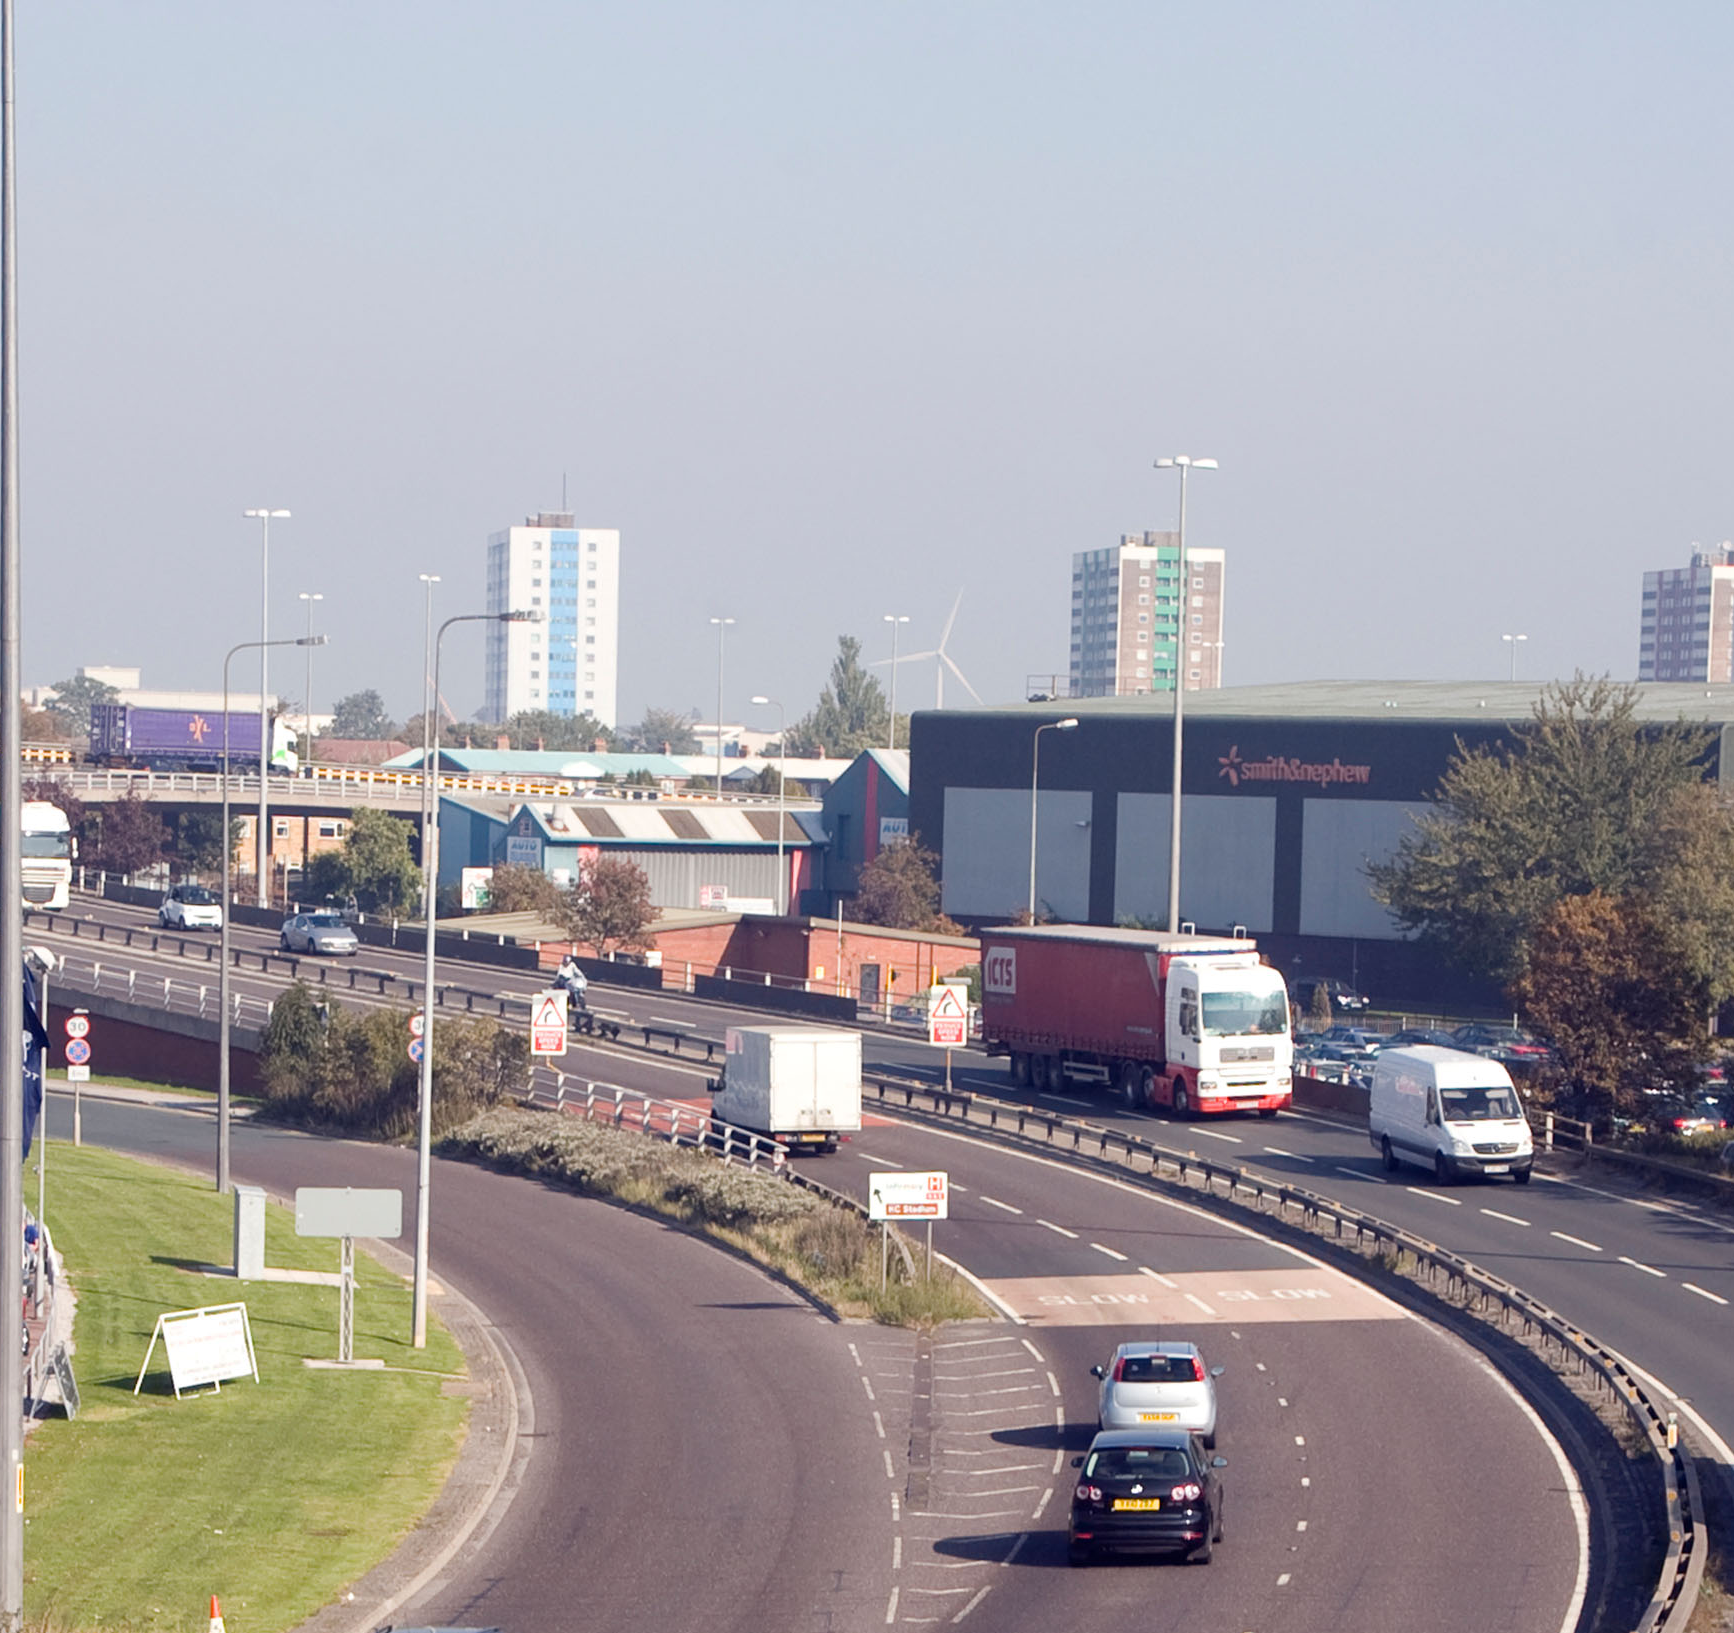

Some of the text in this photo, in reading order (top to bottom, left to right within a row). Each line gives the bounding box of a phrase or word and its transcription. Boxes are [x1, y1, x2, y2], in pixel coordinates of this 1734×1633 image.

[1241, 756, 1371, 788] smith&nephew
[988, 957, 1013, 987] ICTS
[70, 1021, 87, 1032] 30
